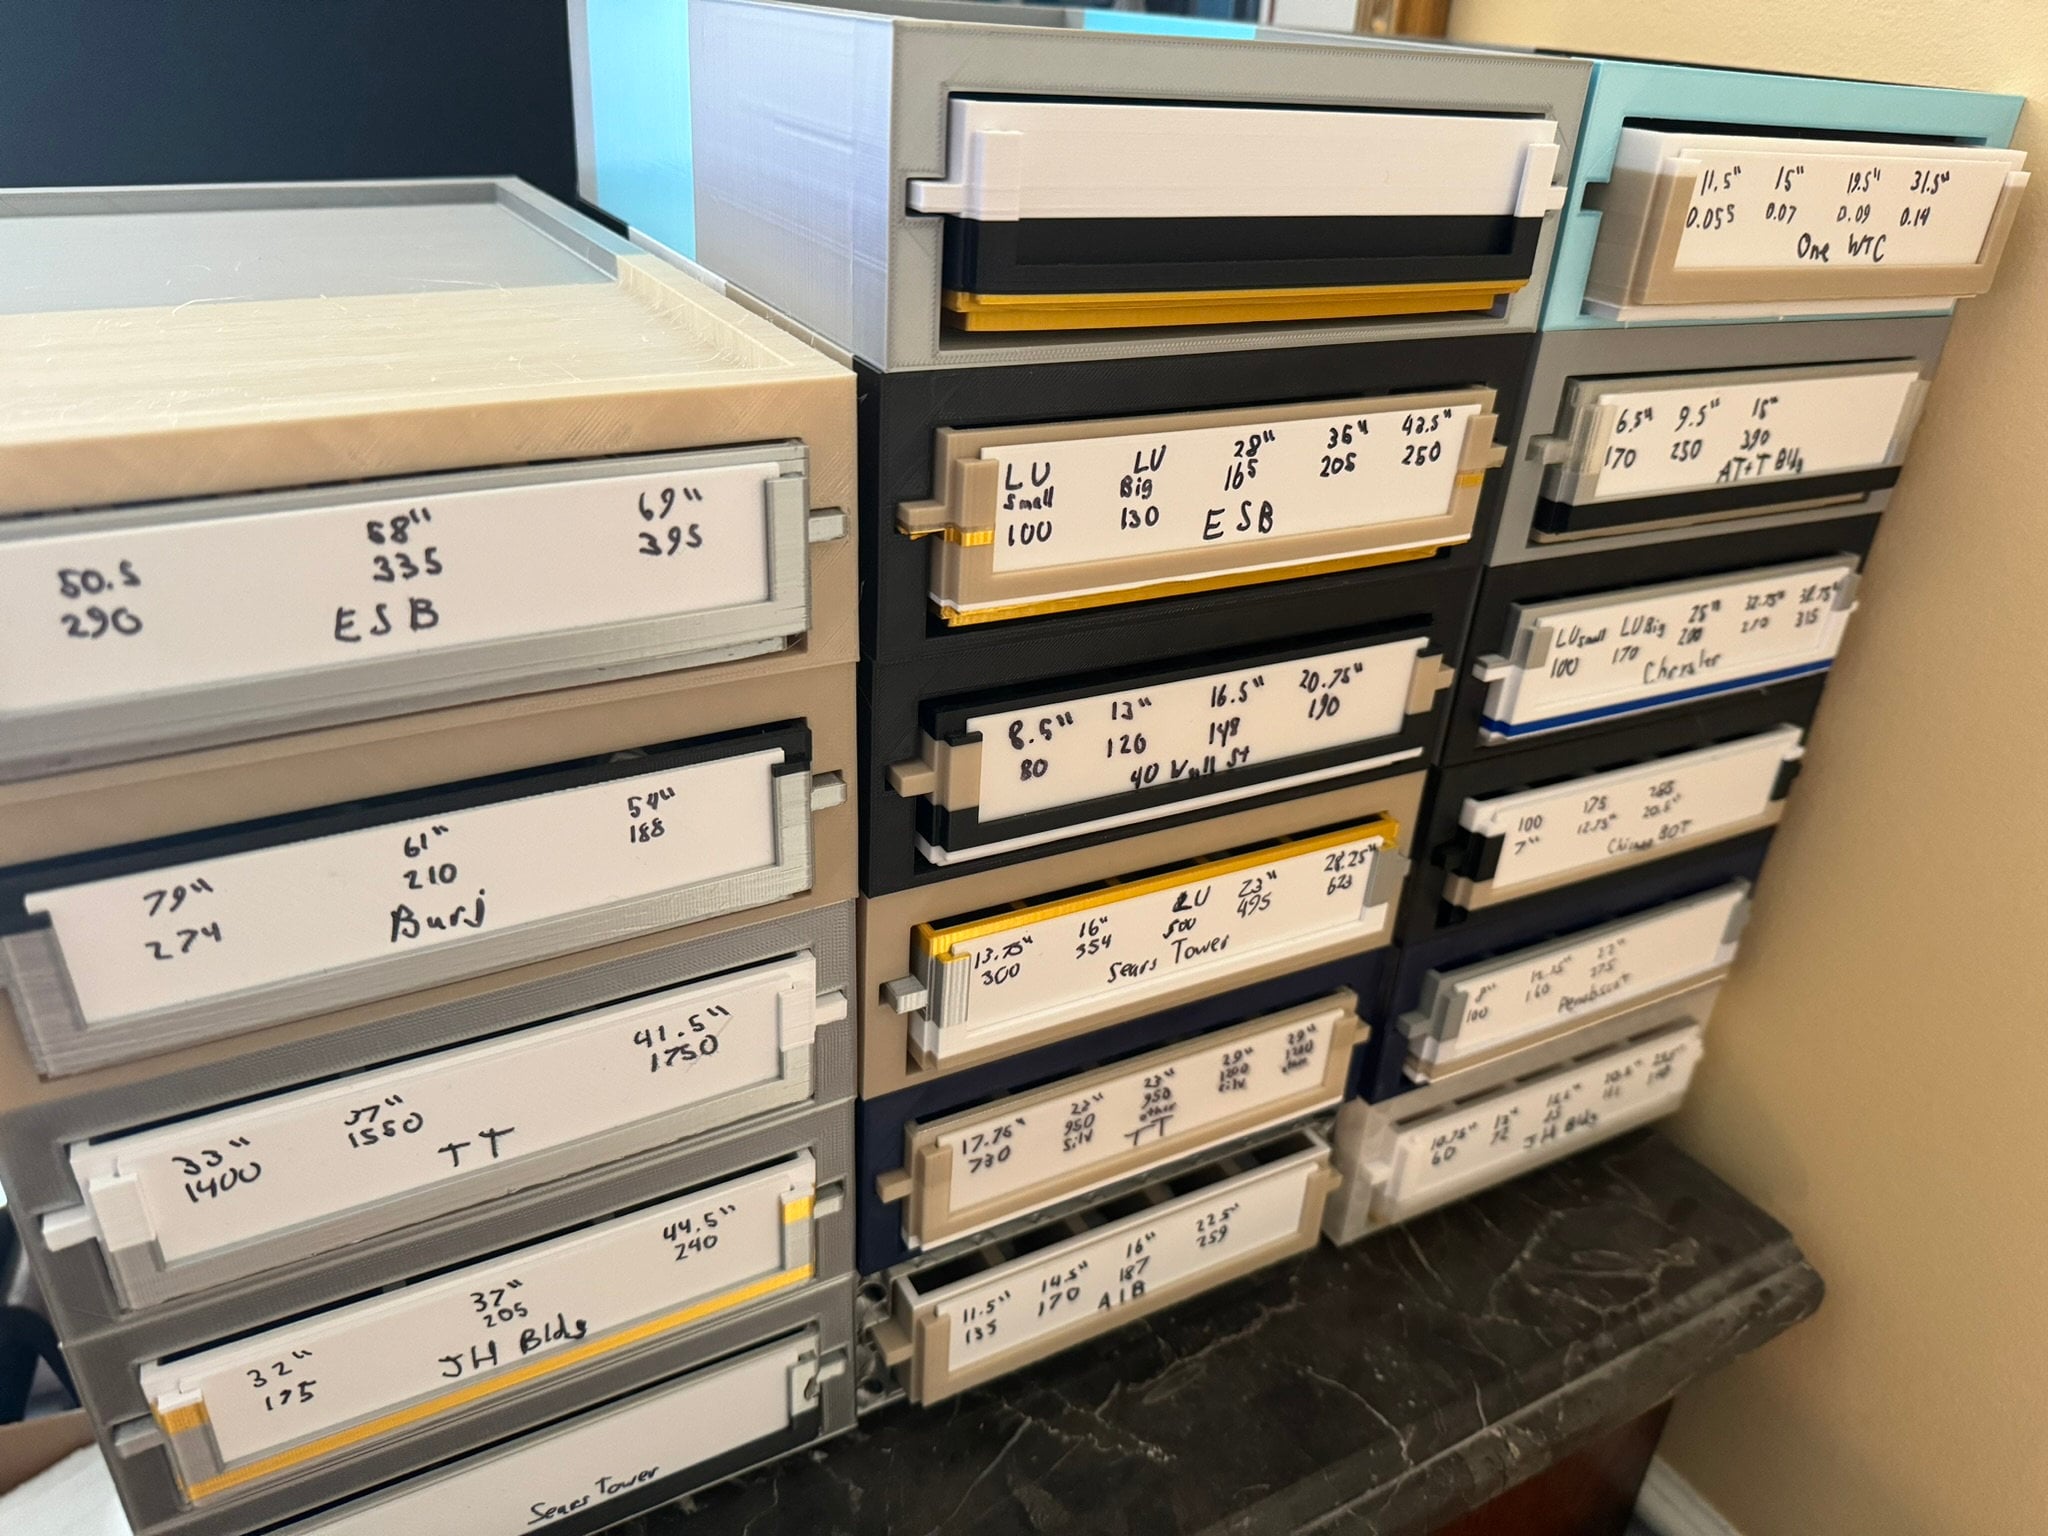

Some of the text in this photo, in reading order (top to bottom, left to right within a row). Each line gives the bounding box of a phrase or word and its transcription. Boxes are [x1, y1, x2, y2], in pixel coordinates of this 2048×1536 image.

[1700, 165, 1742, 197] 11.5"
[1774, 165, 1805, 193] 15"
[1846, 167, 1881, 194] 19.5"
[1685, 201, 1931, 231] 0.055 0.07 0.09 0.14
[1797, 232, 1887, 263] One WTC
[1224, 458, 1259, 492] 165
[1319, 452, 1357, 478] 205
[1401, 440, 1442, 467] 250
[1233, 429, 1276, 459] 28"
[1326, 419, 1369, 450] 36"
[1604, 428, 1771, 469] 170 250 390
[638, 487, 703, 522] 69"
[1008, 505, 1160, 547] 100 130
[60, 523, 703, 640] 290 335 395
[1551, 656, 1579, 678] 100
[1612, 645, 1640, 664] 170
[1008, 662, 1364, 751] 8.5" 13" 16.5" 20.75"
[1019, 692, 1341, 782] 80 120 148 190
[1130, 762, 1160, 791] 40
[1518, 815, 1543, 832] 100
[1584, 796, 1607, 814] 175
[142, 877, 214, 917] 79"
[403, 825, 449, 859] 61"
[1515, 836, 1540, 855] 7"
[144, 817, 665, 961] 274 210 188
[1078, 915, 1108, 939] 16"
[1237, 869, 1278, 899] 23"
[981, 873, 1353, 986] 300 354 500 495 623
[1107, 934, 1230, 984] Sears Tower
[171, 1004, 730, 1177] 33" 37" 41.5"
[1063, 1113, 1095, 1136] 950
[1142, 1087, 1172, 1110] 950
[181, 1034, 719, 1204] 1400 1550 1750
[246, 1204, 736, 1391] 32" 37" 44.5"
[963, 1290, 1011, 1323] 11.5"
[1127, 1231, 1157, 1259] 16"
[966, 1320, 996, 1345] 135
[1038, 1287, 1080, 1317] 170
[1119, 1255, 1151, 1282] 187
[265, 1234, 718, 1412] 175 205 240
[527, 1466, 660, 1526] Sears Tower
